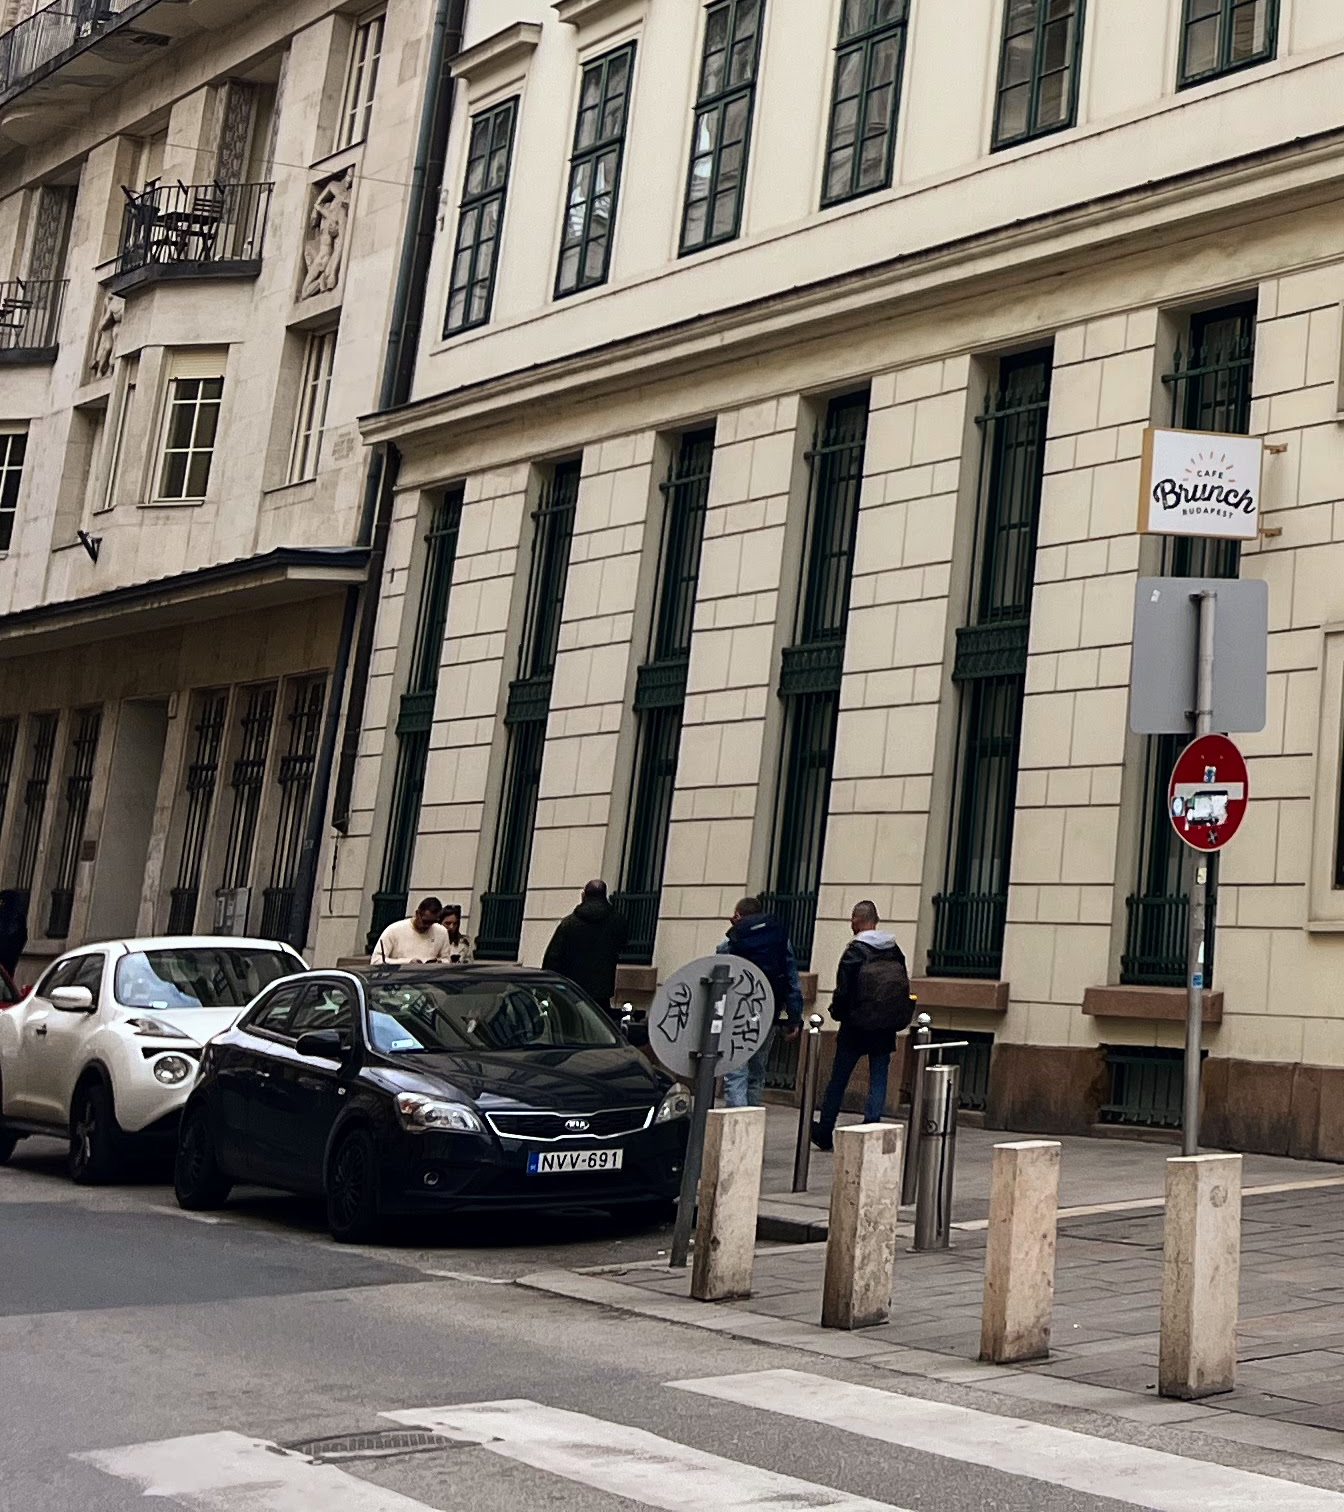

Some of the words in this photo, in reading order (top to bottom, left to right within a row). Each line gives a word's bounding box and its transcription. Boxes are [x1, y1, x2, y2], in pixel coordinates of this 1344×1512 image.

[1197, 470, 1224, 479] CAFE
[1153, 478, 1256, 514] Brunch
[1182, 507, 1233, 519] BUDAPEST
[542, 1152, 618, 1171] NVV-691
